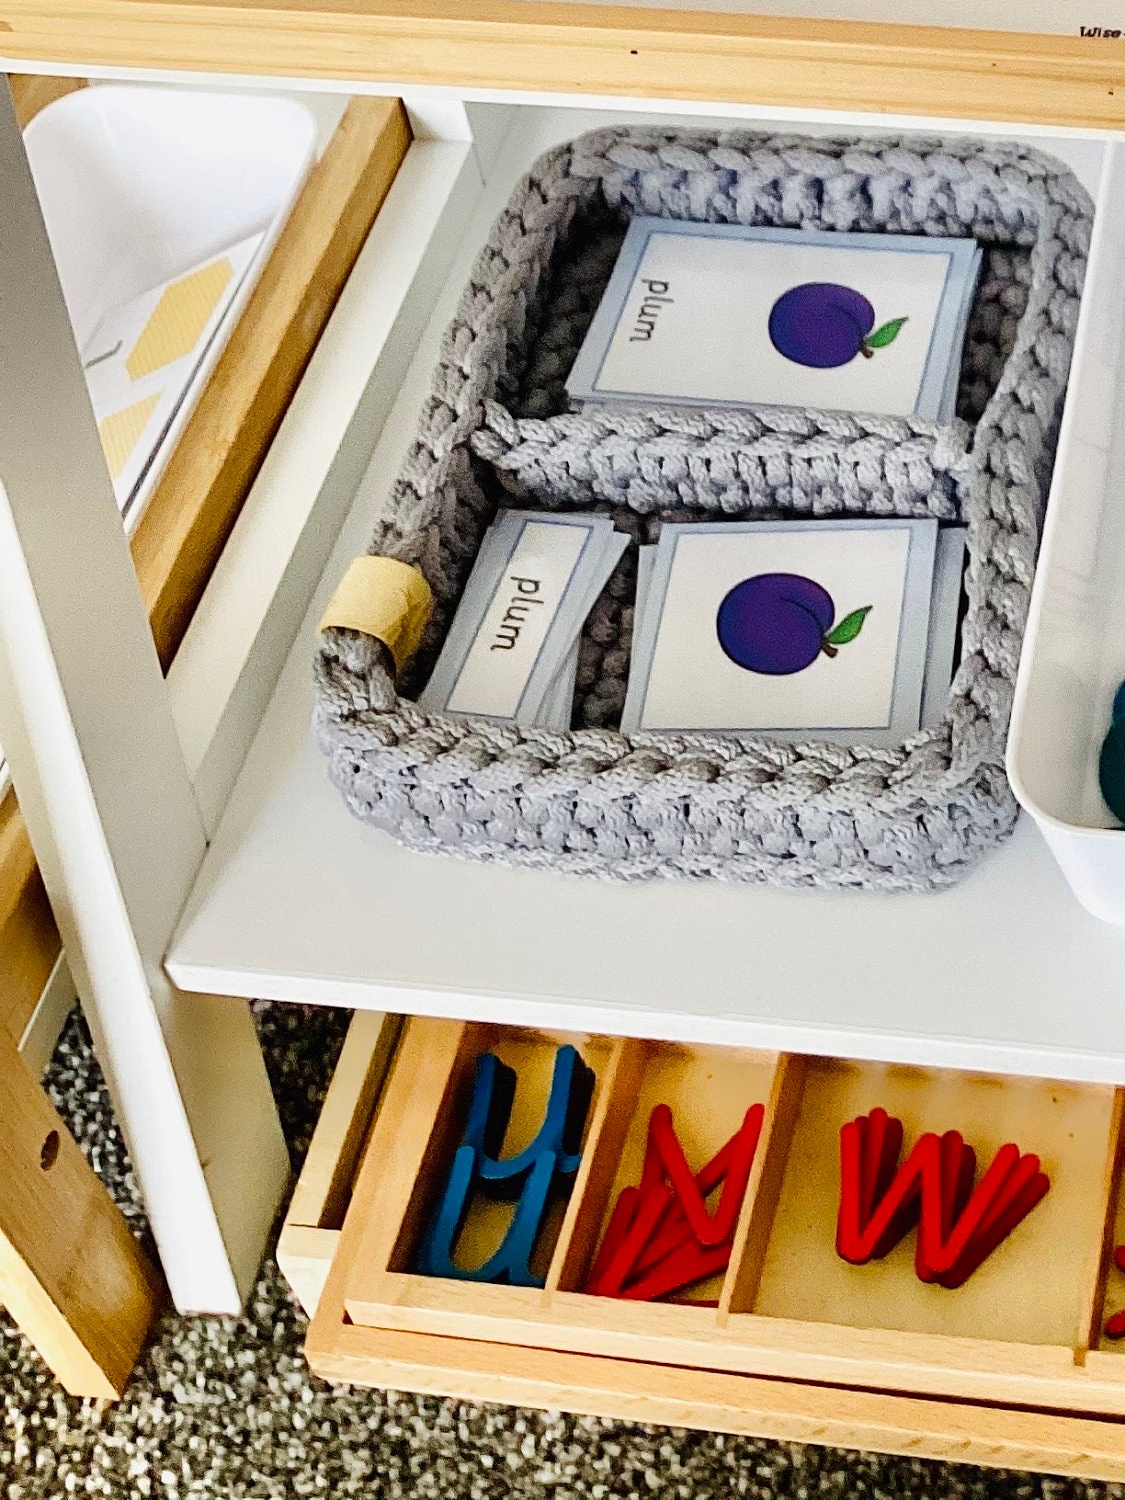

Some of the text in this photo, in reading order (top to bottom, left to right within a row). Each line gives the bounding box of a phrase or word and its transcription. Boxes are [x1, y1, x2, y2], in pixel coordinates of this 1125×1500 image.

[1079, 26, 1121, 38] Wise
[629, 278, 675, 343] plum
[490, 575, 541, 651] plum
